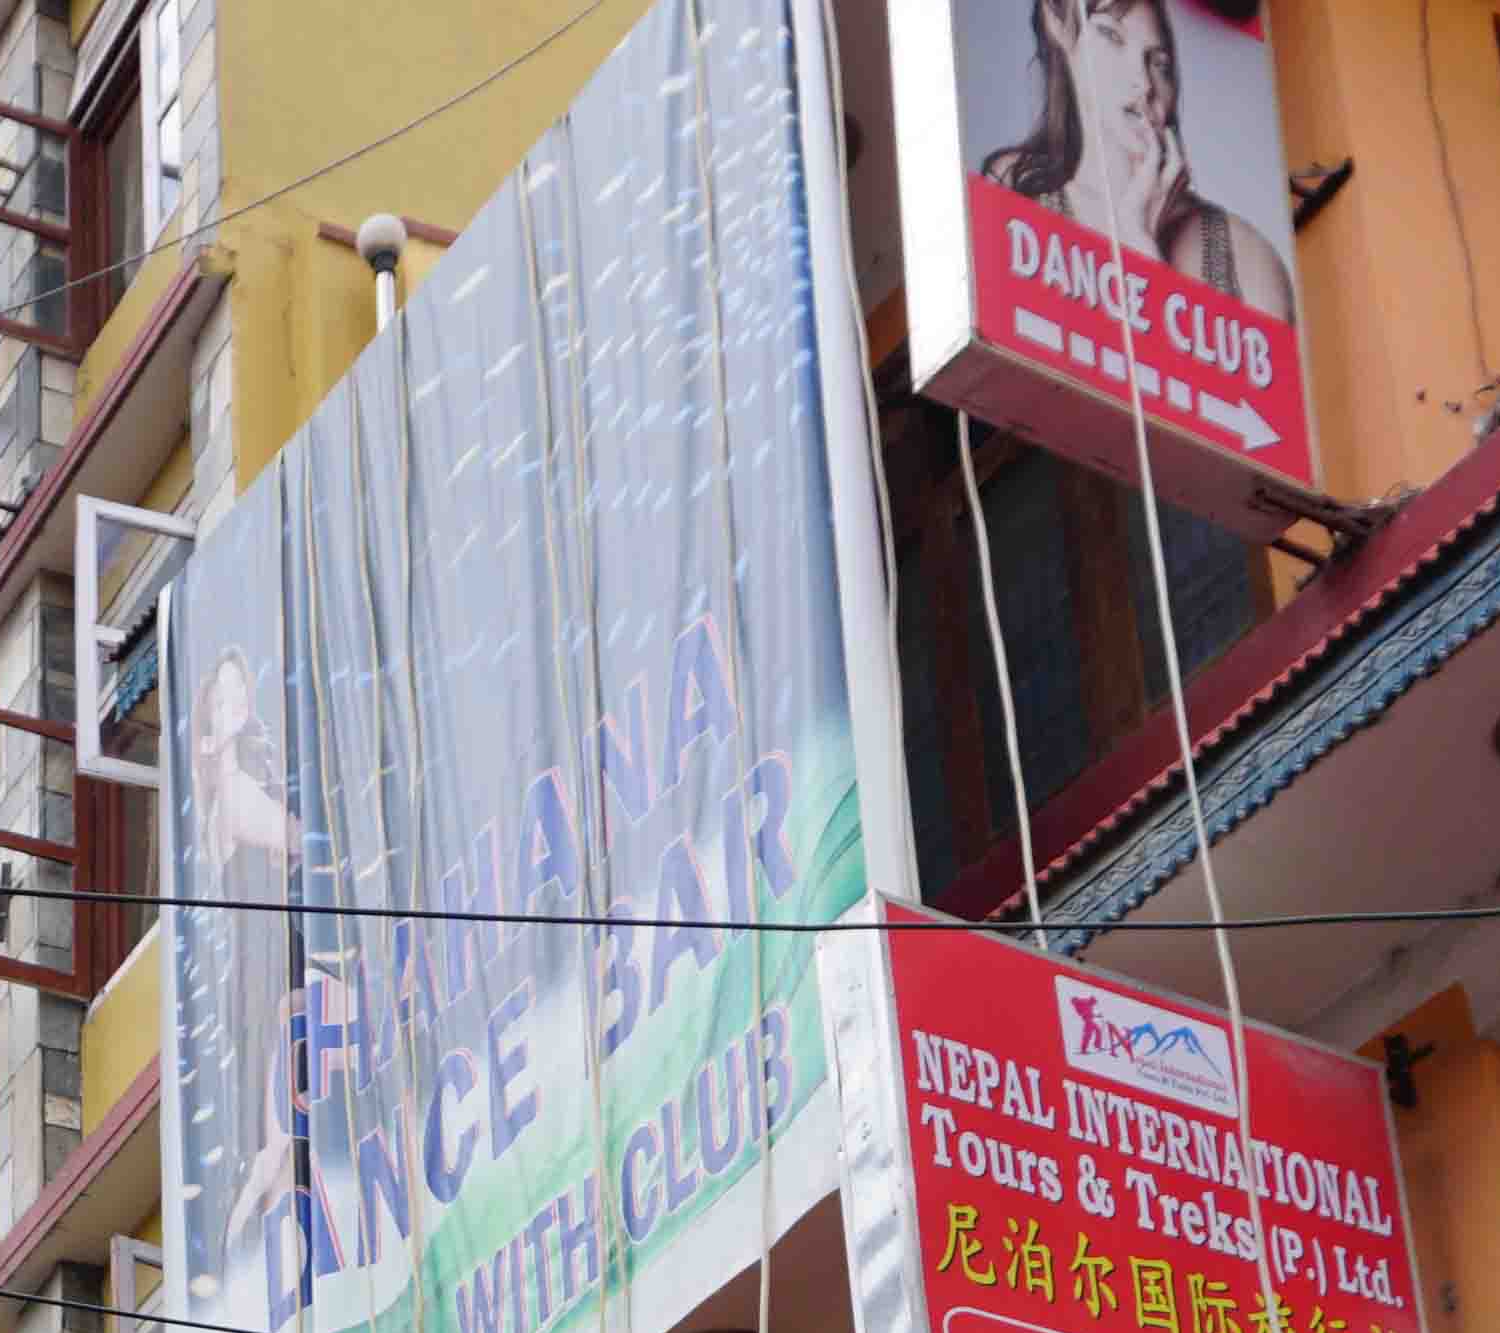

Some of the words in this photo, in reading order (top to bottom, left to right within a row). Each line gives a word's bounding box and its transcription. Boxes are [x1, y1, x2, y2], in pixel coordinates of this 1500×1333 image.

[1007, 218, 1151, 331] DANCE
[1163, 293, 1273, 388] CLUB
[587, 751, 793, 1059] BAR
[620, 1005, 791, 1244] CLUB
[912, 1029, 1054, 1129] NEPAL
[1063, 1079, 1393, 1237] INTERNATIONAL
[921, 1103, 1063, 1204] Tours
[1077, 1158, 1115, 1219] &
[1124, 1172, 1258, 1261] Treks
[1337, 1254, 1404, 1308] Ltd.
